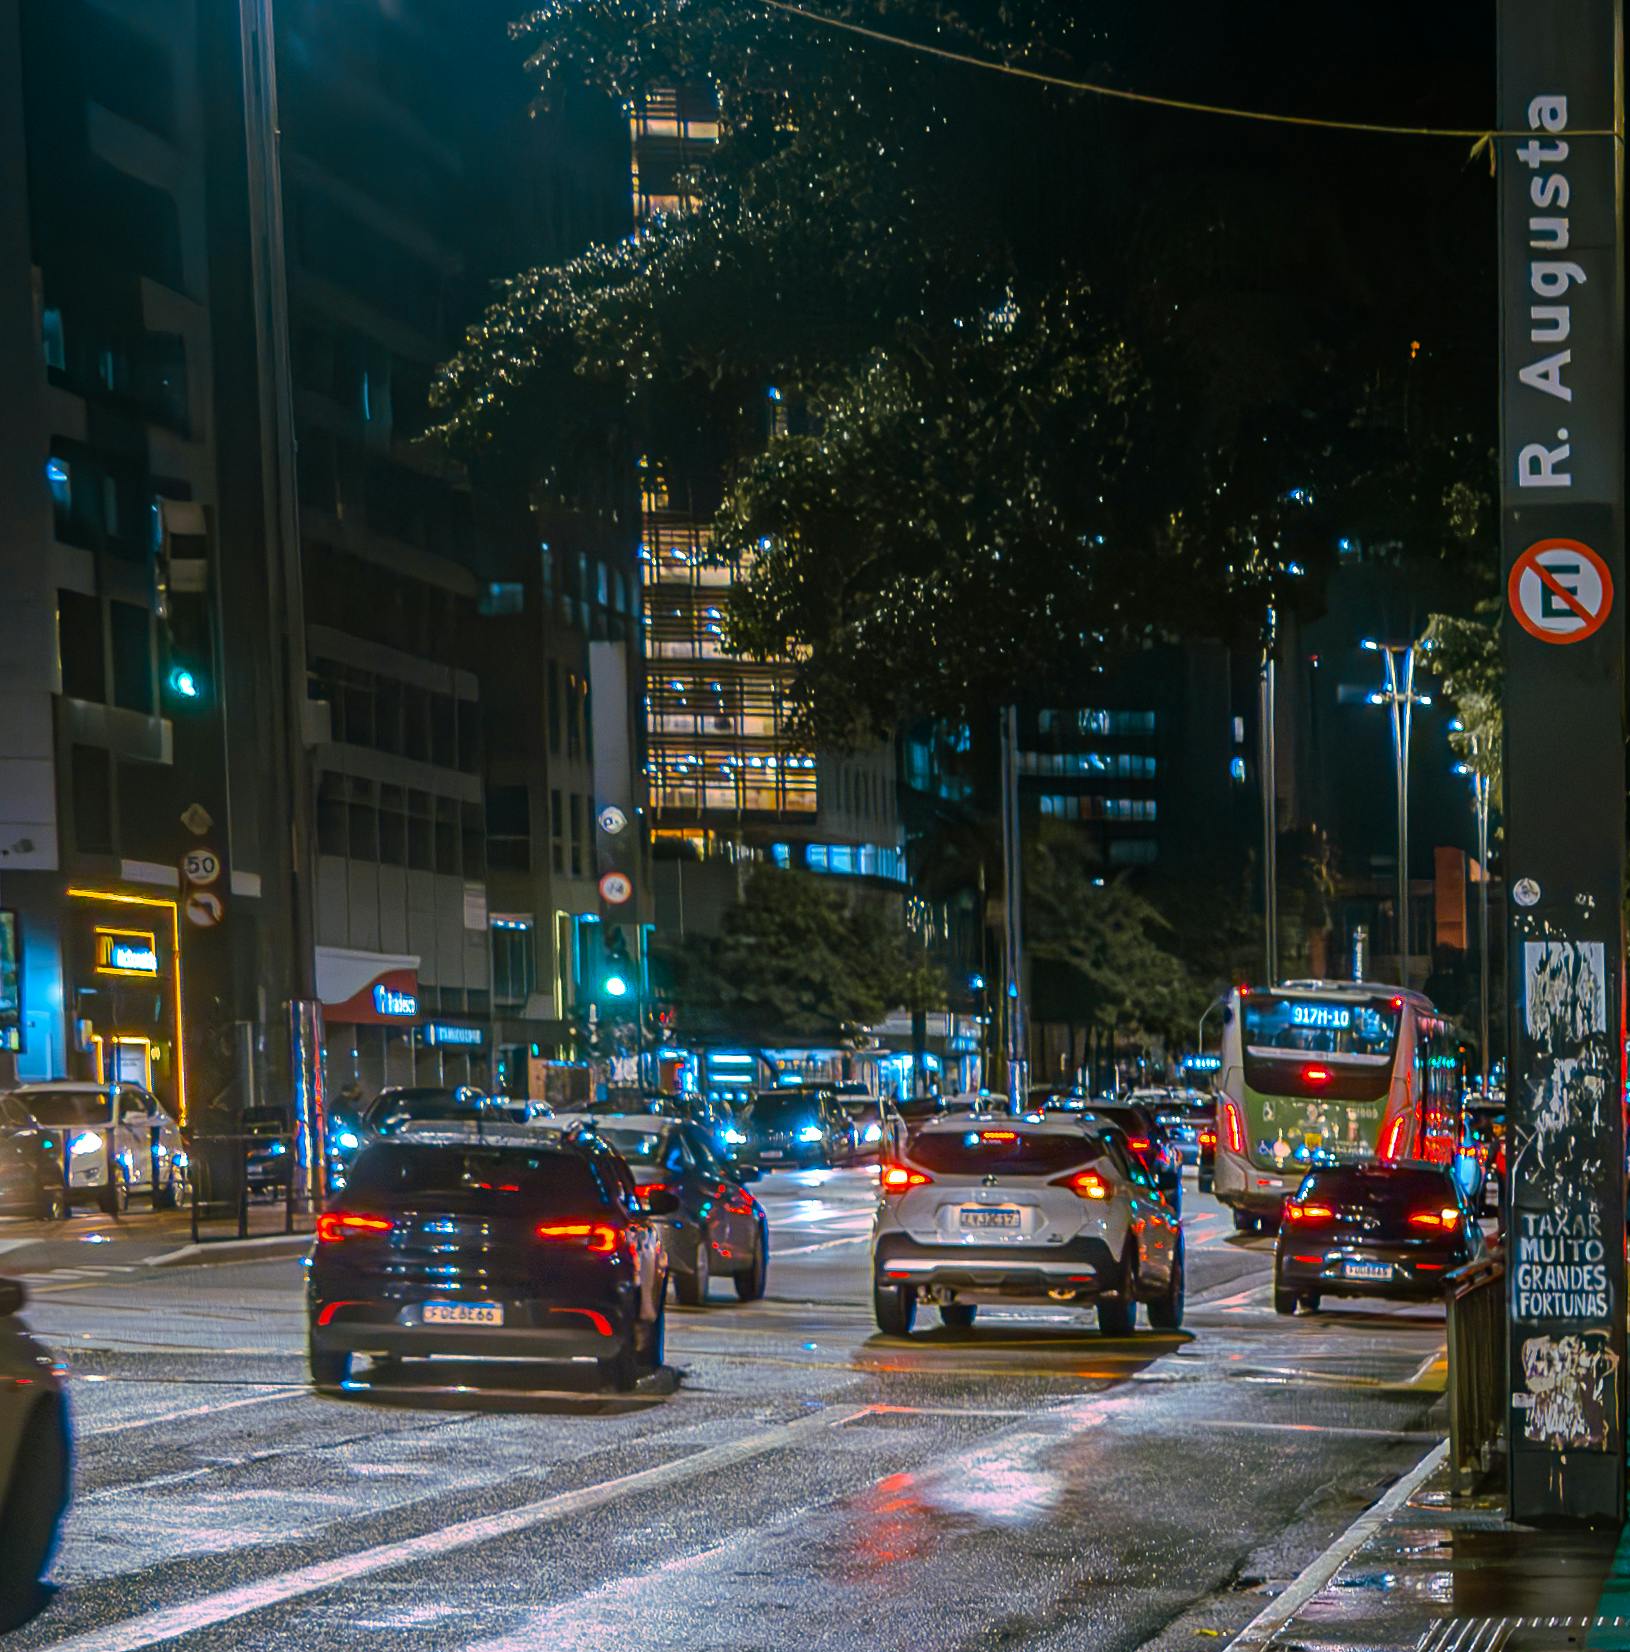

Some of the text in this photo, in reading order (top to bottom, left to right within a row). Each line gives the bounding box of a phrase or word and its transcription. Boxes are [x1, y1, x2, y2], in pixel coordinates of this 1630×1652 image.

[1516, 94, 1587, 488] R. Augusta
[188, 856, 215, 873] 50
[1522, 1213, 1602, 1237] TAXAR
[1520, 1235, 1604, 1263] MUITO
[1517, 1263, 1607, 1291] GRANDES
[1519, 1291, 1608, 1317] FORTUNAS
